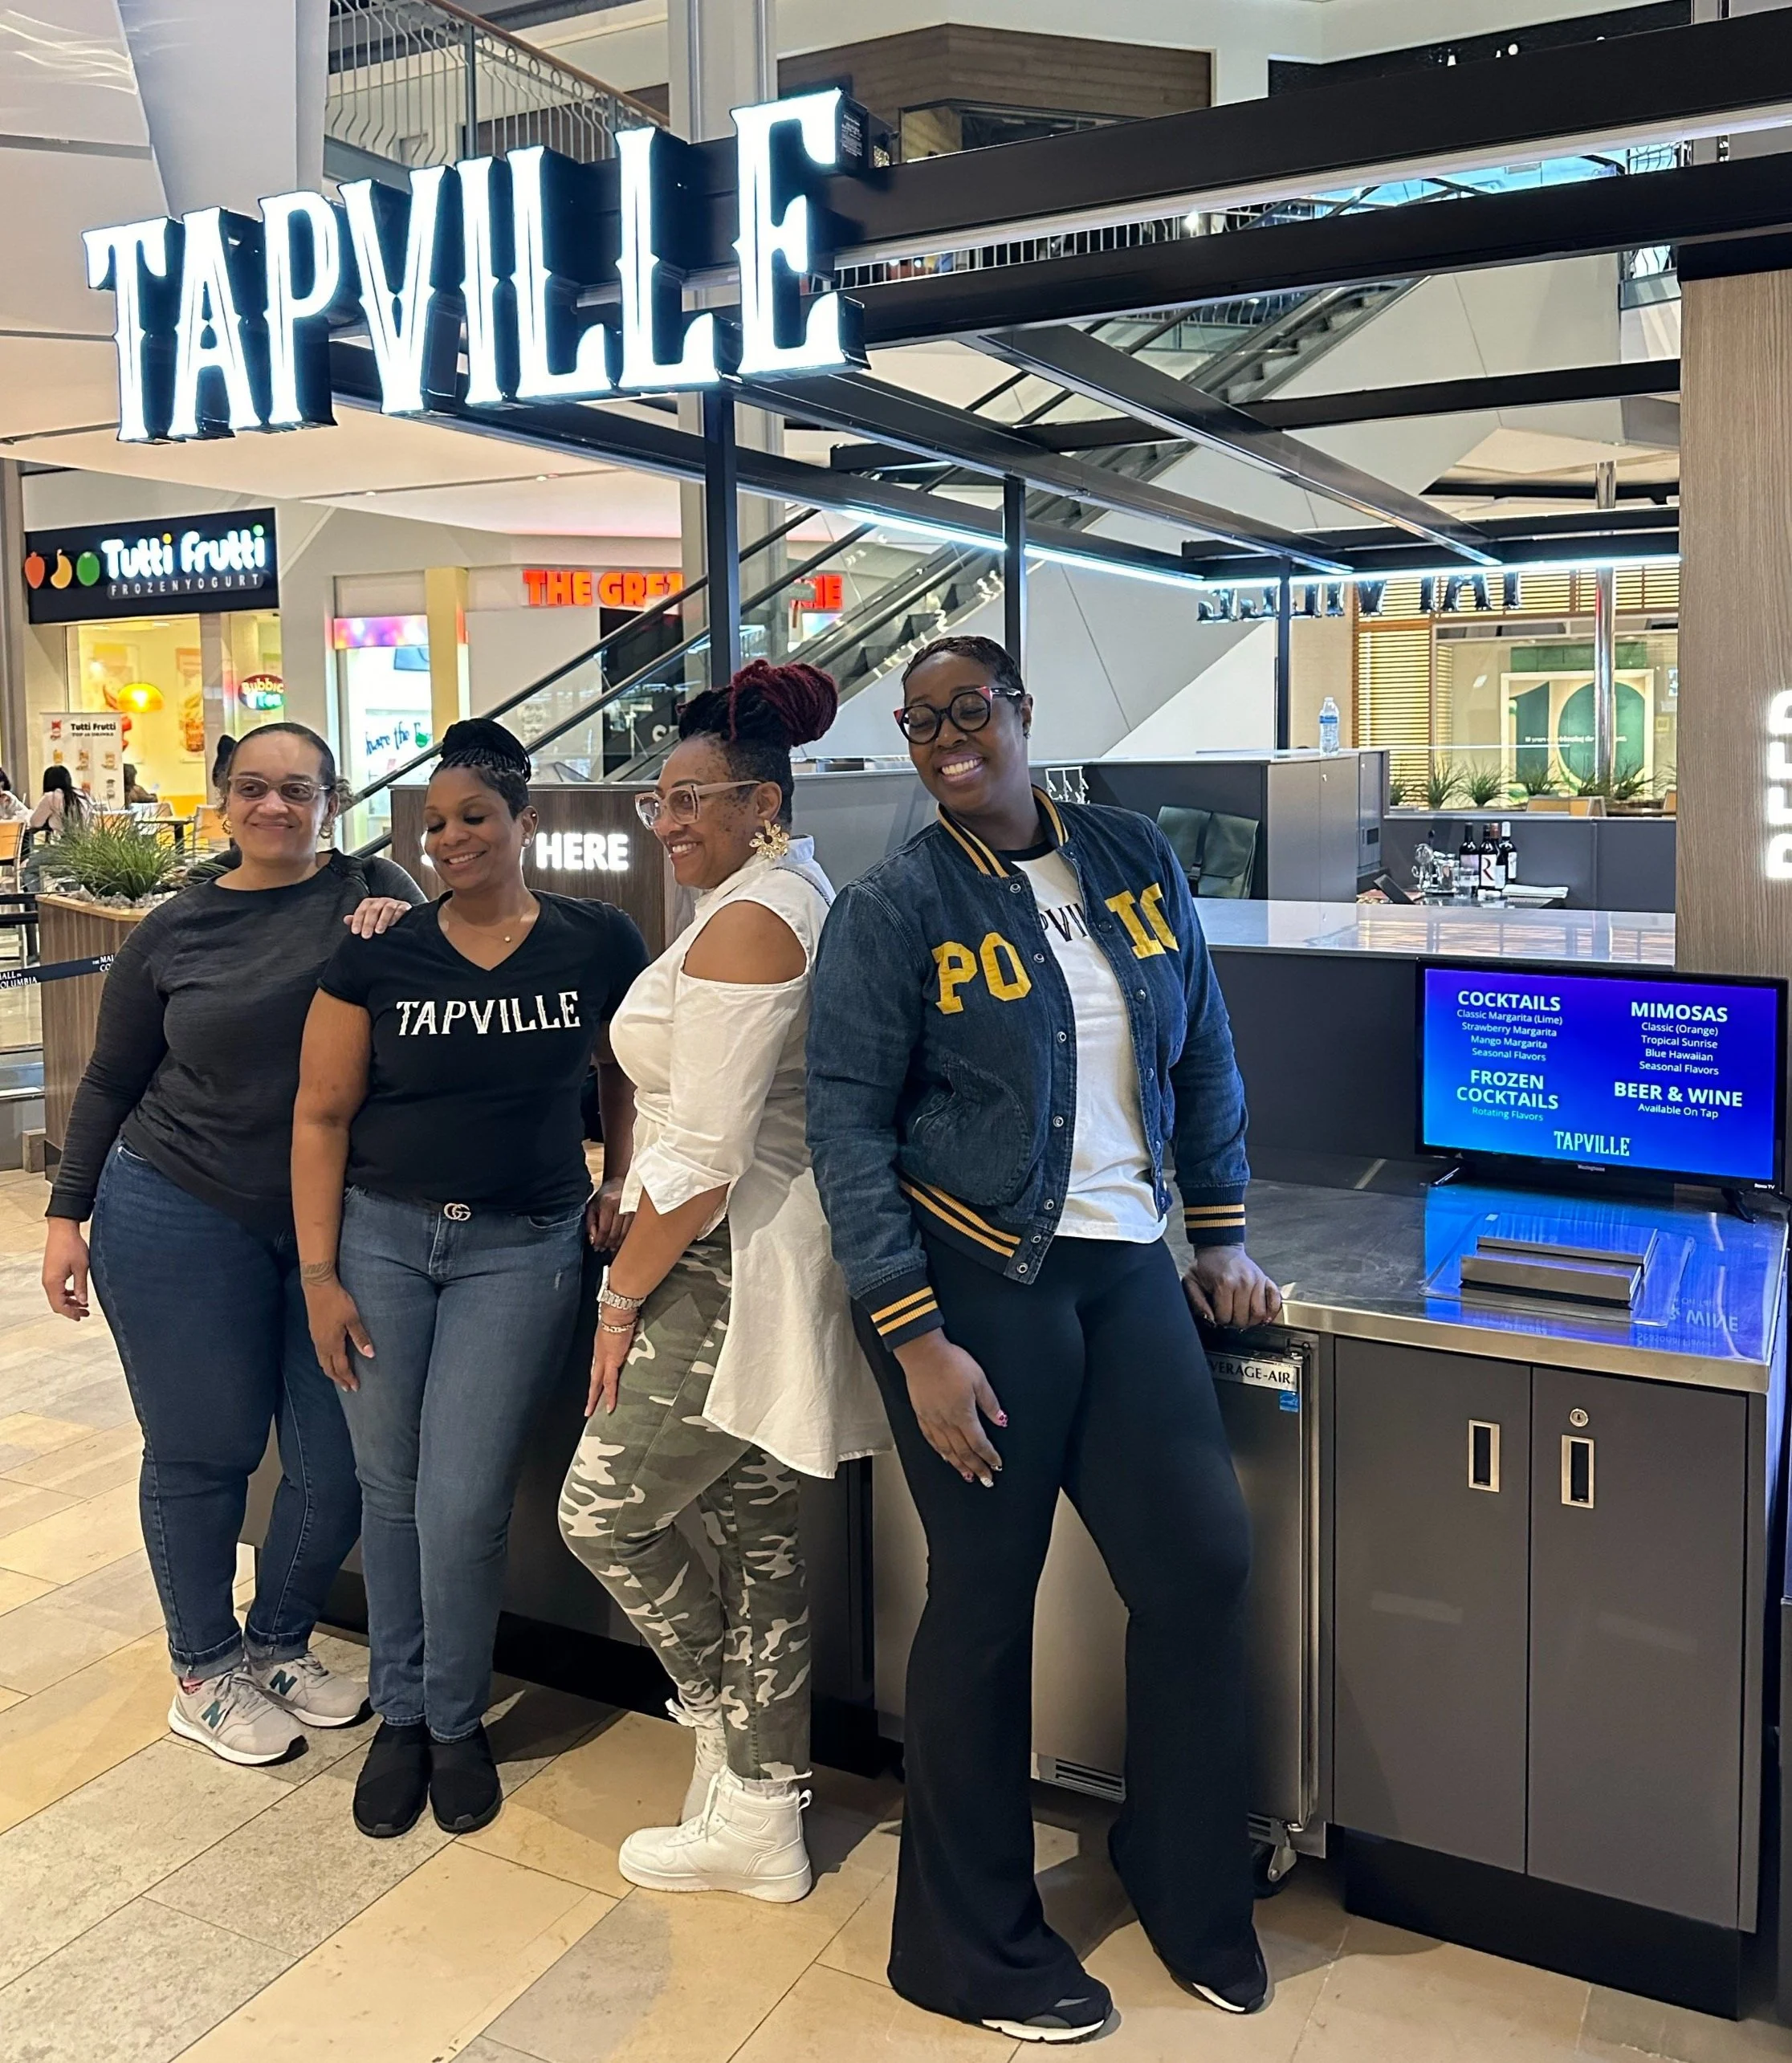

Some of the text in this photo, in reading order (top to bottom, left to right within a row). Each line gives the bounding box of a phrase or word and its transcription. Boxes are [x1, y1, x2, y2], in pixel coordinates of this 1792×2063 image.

[82, 88, 847, 442] TAPVILLE
[101, 533, 173, 580] Tutti
[523, 569, 593, 606] THE
[71, 722, 116, 730] Tutti Frutti
[536, 832, 629, 870] HERE
[0, 976, 38, 988] OLUMBIA
[931, 932, 1032, 1015] PO
[1458, 991, 1561, 1011] COCKTAILS
[396, 991, 581, 1036] TAPVILLE
[1457, 1009, 1563, 1026] Classic Margarita (Lime)
[1631, 1002, 1728, 1022] MIMOSAS
[1461, 1022, 1558, 1037] Strawberry Margarita
[1641, 1022, 1719, 1037] Classic (Orange)
[1471, 1036, 1548, 1049] Mango Margarita
[1641, 1035, 1718, 1049] Tropical Sunrise
[1472, 1048, 1546, 1061] Seasonal Flavors
[1645, 1048, 1713, 1062] Blue Hawaiian
[1639, 1060, 1719, 1076] Seasonal Flavors
[1470, 1069, 1544, 1090] FROZEN
[1456, 1086, 1558, 1109] COCKTAILS
[1614, 1081, 1743, 1108] BEER & WINE
[1472, 1107, 1544, 1121] Rotating Flavors
[1637, 1103, 1719, 1121] Available On Tap
[1553, 1130, 1631, 1157] TAPVILLE
